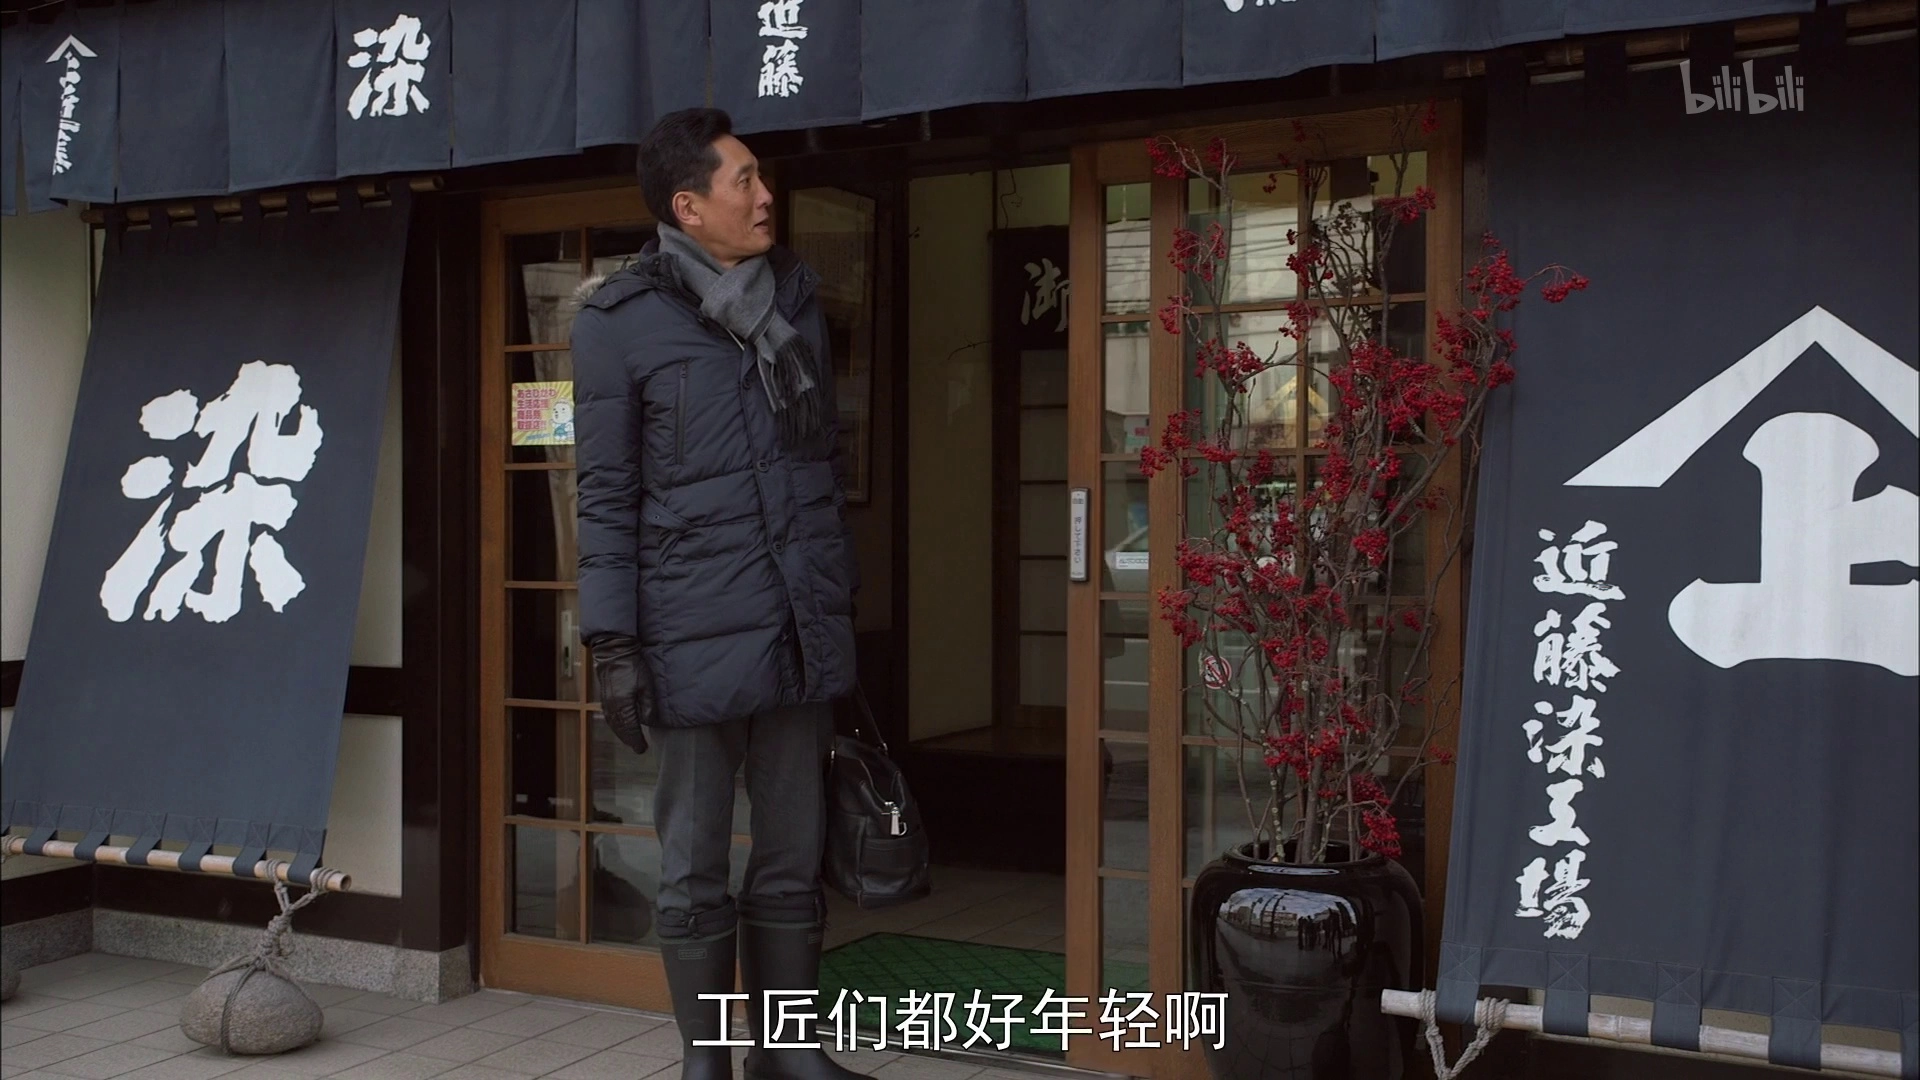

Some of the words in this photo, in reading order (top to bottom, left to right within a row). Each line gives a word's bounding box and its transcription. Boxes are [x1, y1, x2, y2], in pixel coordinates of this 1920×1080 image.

[347, 13, 432, 120] 染
[100, 359, 324, 624] 染
[1514, 519, 1626, 940] 近藤染工場
